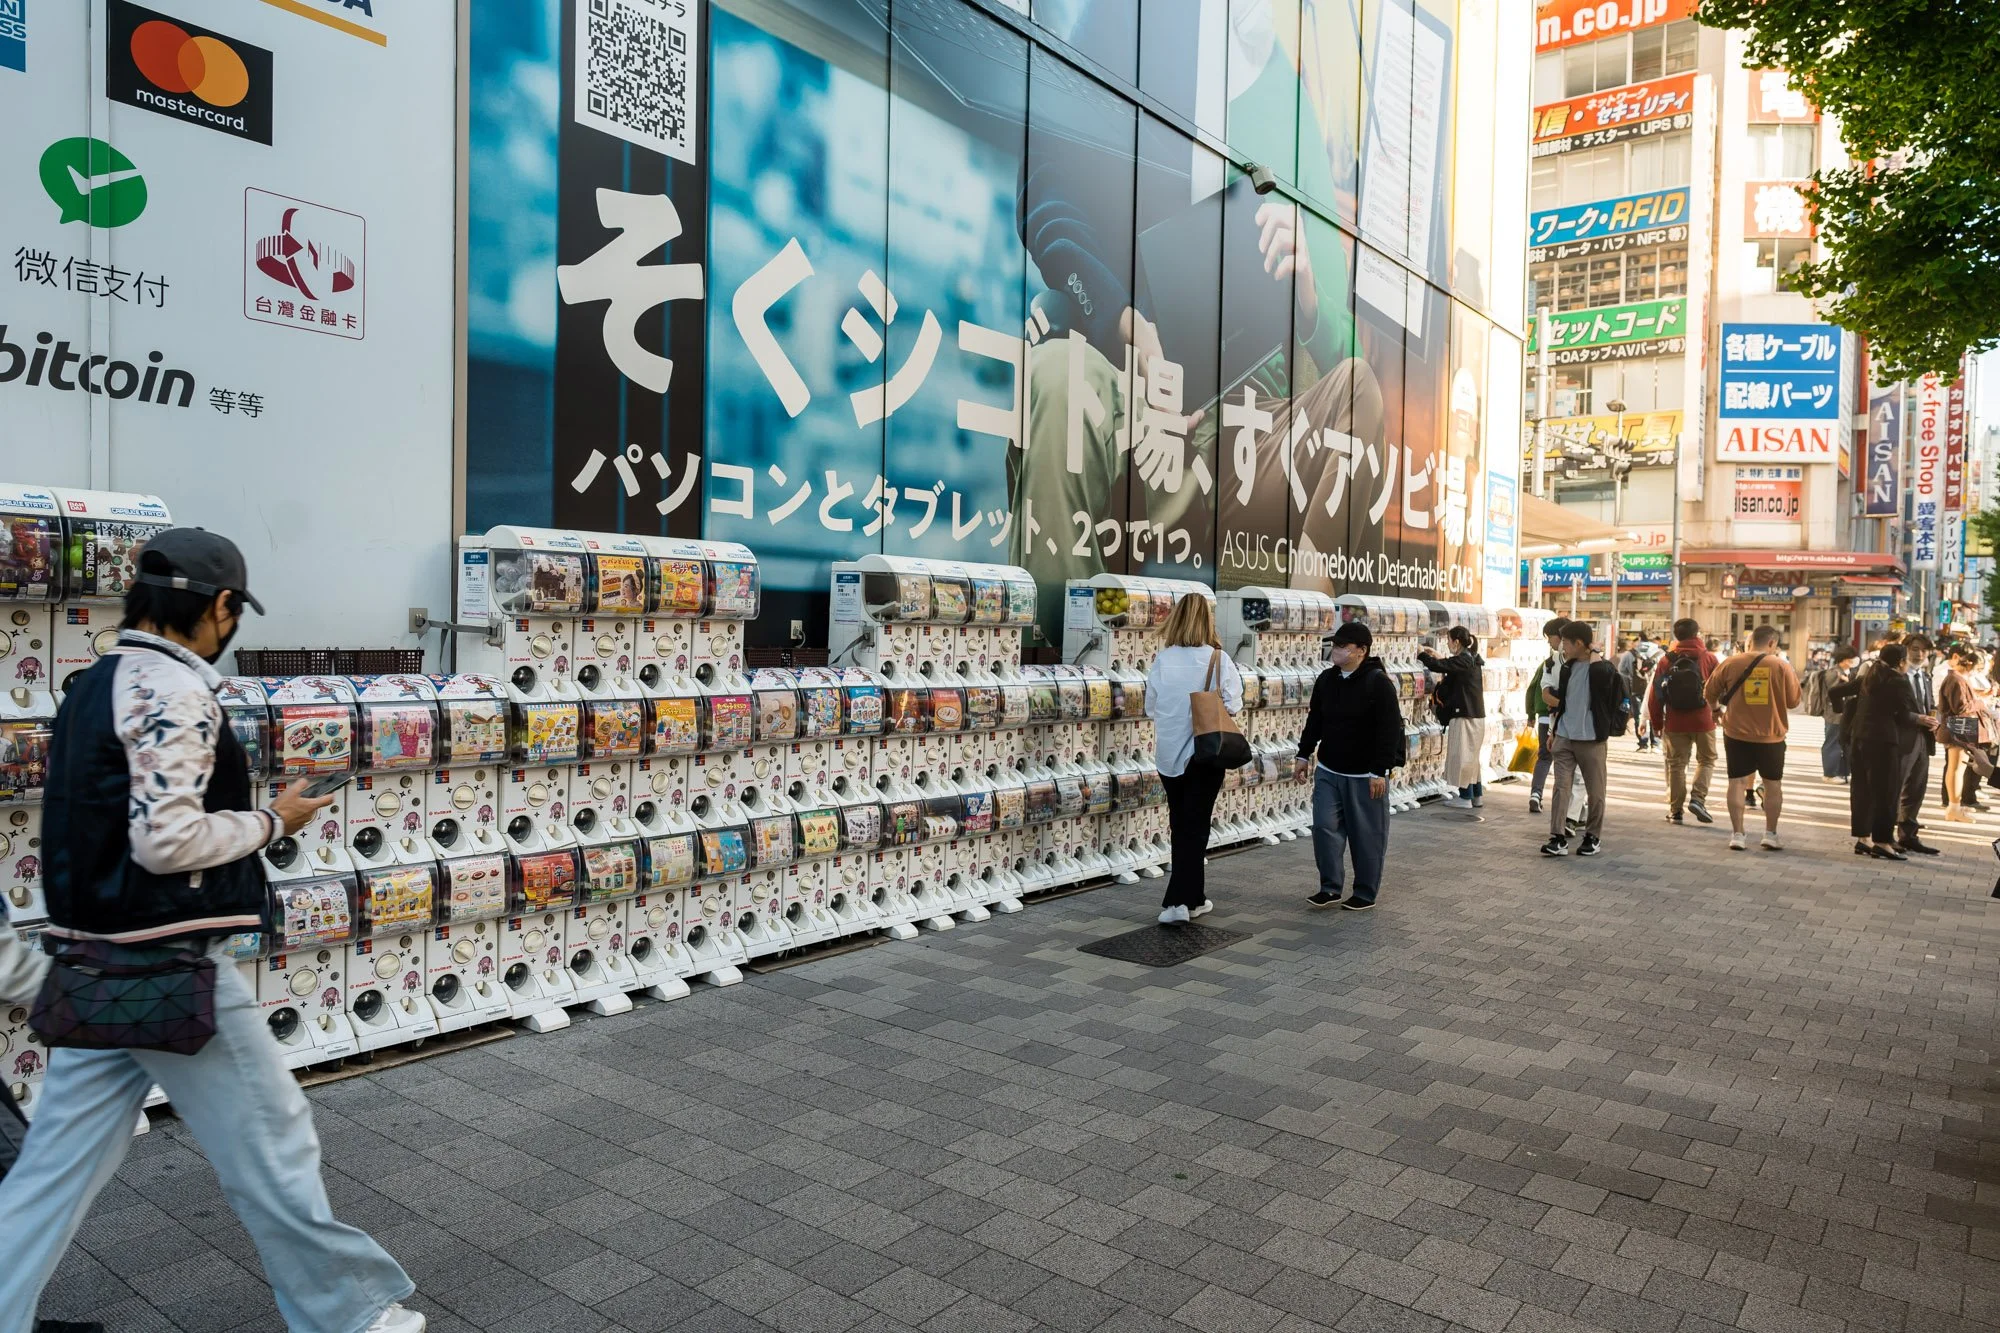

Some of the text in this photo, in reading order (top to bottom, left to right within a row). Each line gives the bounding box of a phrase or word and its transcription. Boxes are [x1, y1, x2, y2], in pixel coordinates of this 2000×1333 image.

[1537, 0, 1668, 46] n.co.jp
[1586, 87, 1648, 110] ネットワーク
[1596, 92, 1690, 126] セキュリティ
[14, 245, 170, 308] 微信支付
[255, 296, 358, 330] 台灣金融卡
[1726, 333, 1837, 361] 各種ケーブル
[0, 325, 196, 408] bitcoin
[209, 387, 264, 418] 等等
[1725, 381, 1833, 410] 配線パーツ
[1723, 427, 1831, 453] AISAN
[1873, 401, 1895, 503] AISAN
[1917, 445, 1939, 495] Shop
[1945, 515, 1957, 572] ダーツバー
[1221, 529, 1270, 571] ASUS
[1274, 538, 1375, 584] Chromebook
[1378, 553, 1447, 592] Detachable
[1449, 563, 1473, 595] CM3
[1768, 586, 1789, 595] 1949
